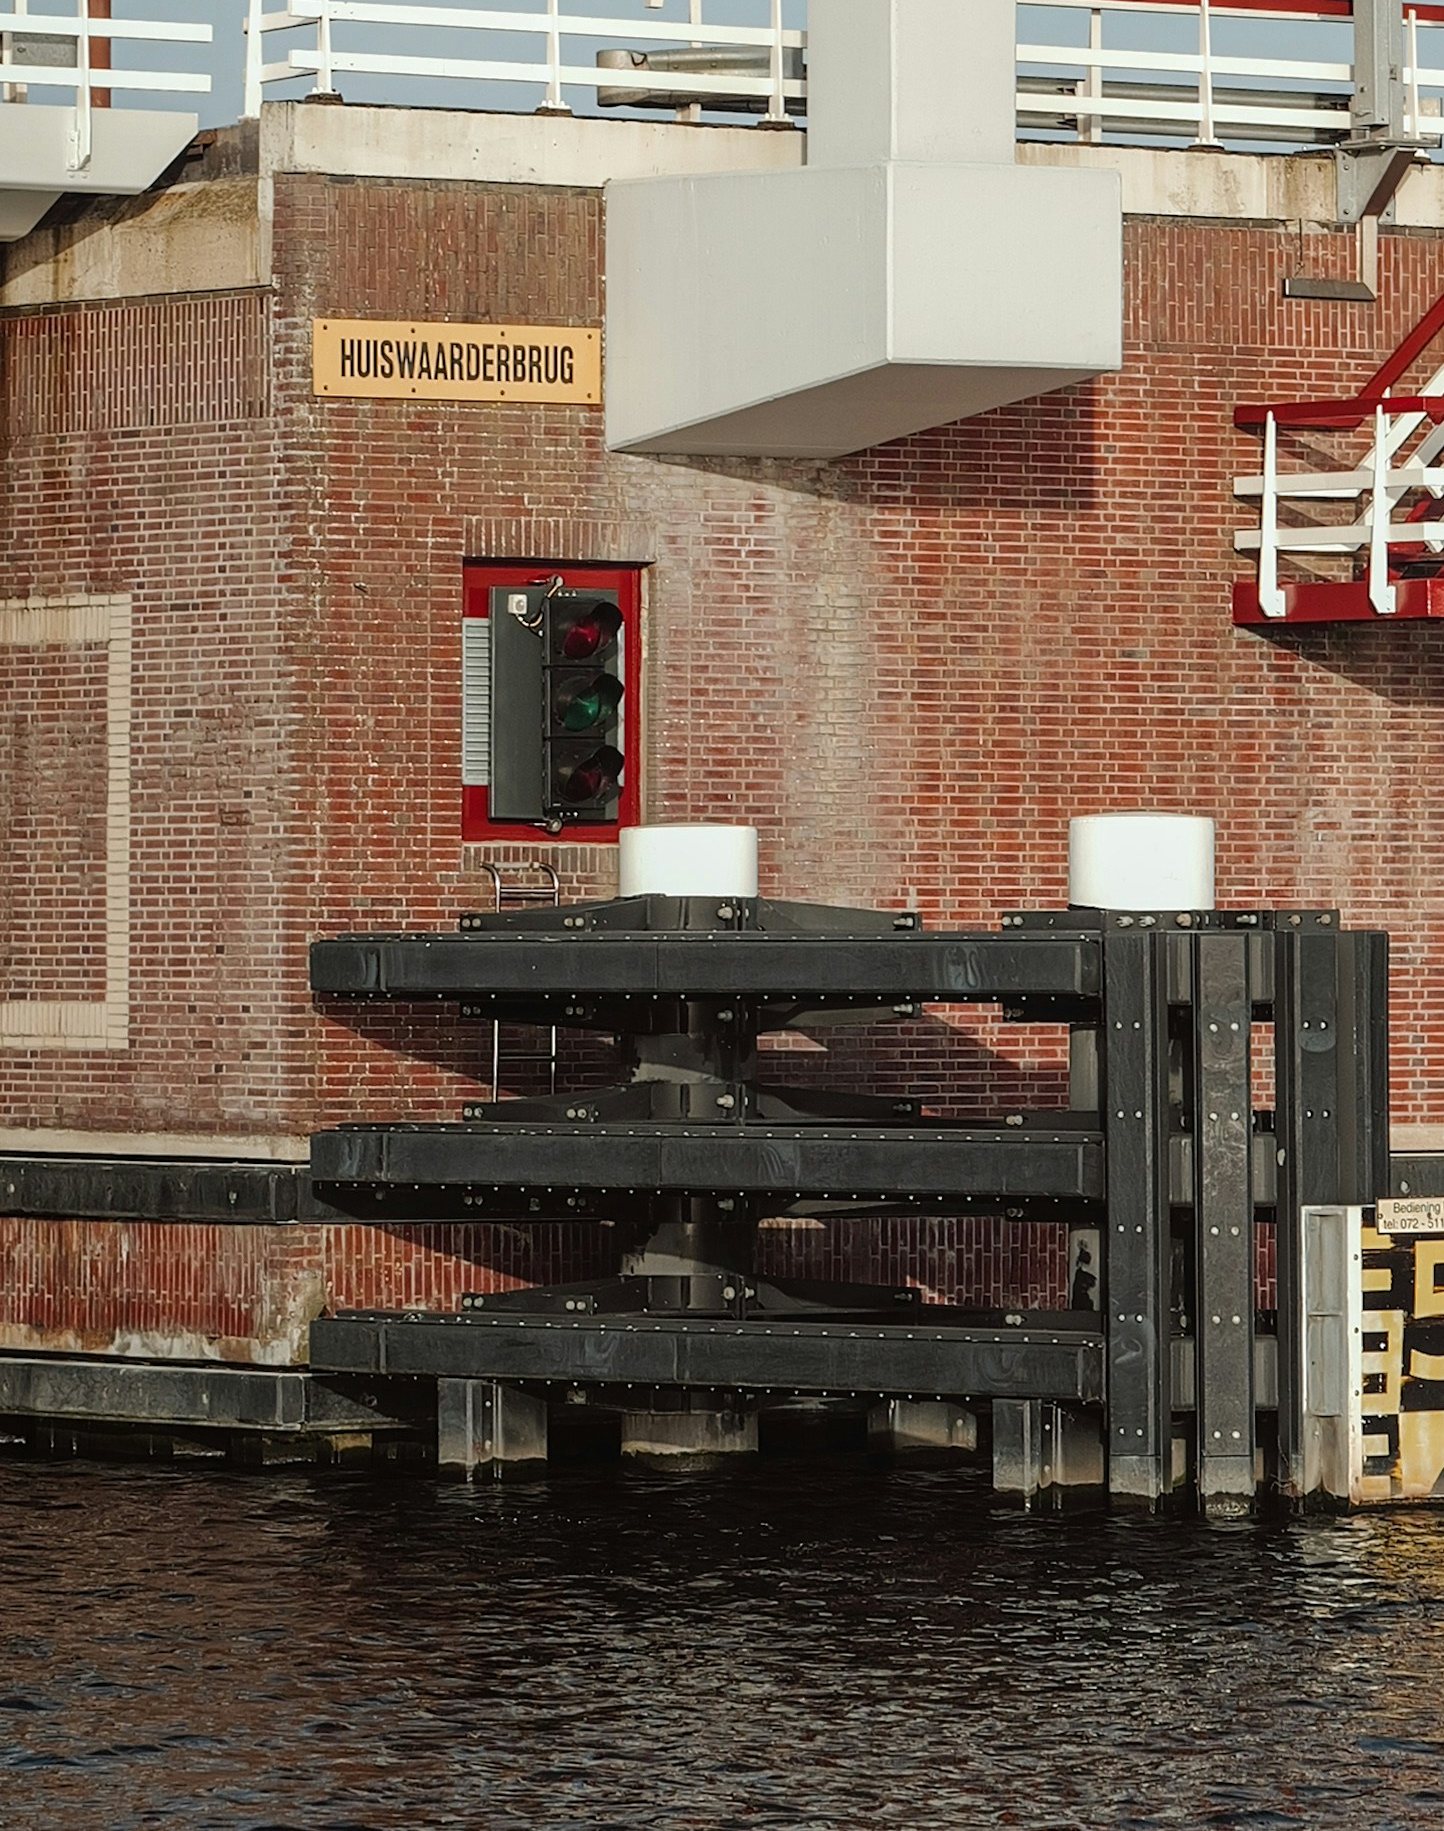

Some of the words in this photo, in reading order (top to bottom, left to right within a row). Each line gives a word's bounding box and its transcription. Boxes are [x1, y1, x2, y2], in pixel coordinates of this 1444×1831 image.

[341, 338, 574, 384] HUISWAARDERBRUG
[1393, 1202, 1441, 1215] Bediening
[1383, 1220, 1399, 1230] tel:
[1400, 1218, 1419, 1230] 072
[1428, 1218, 1444, 1229] 511
